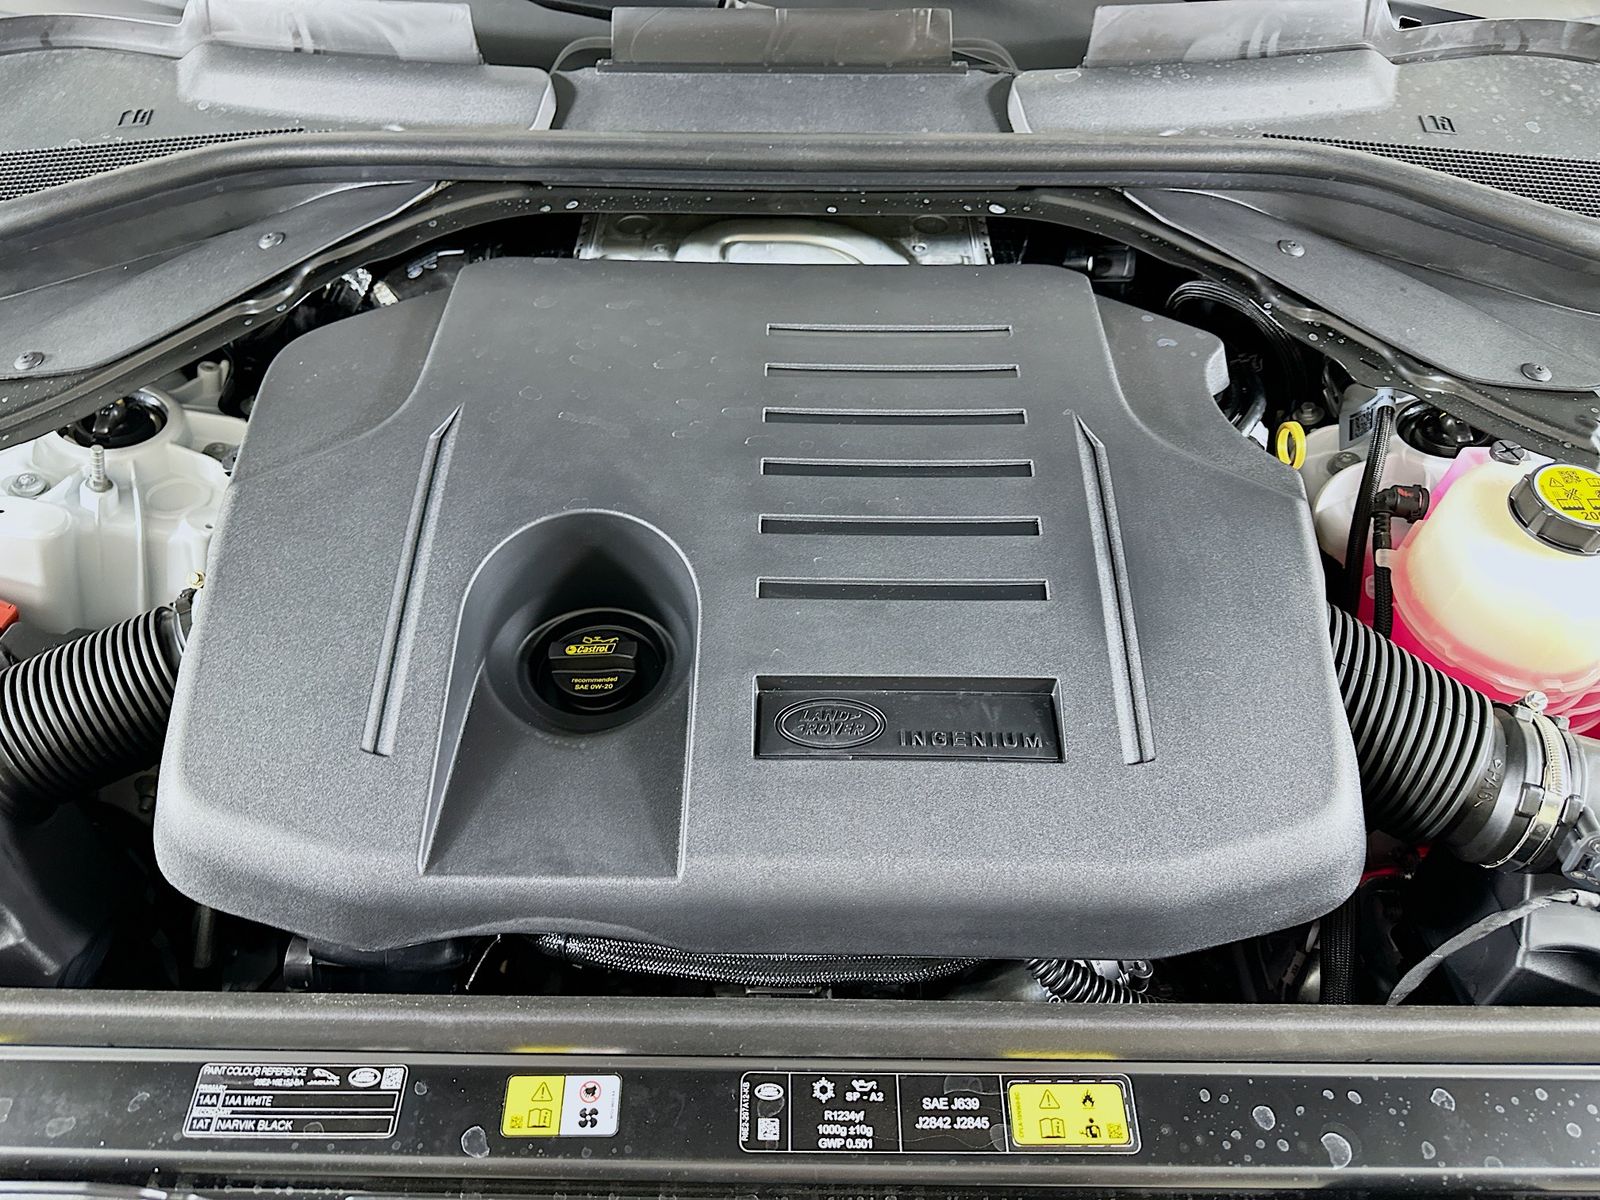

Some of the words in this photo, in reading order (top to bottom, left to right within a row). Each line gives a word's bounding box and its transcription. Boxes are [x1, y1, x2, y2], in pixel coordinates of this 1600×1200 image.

[1581, 511, 1600, 521] 20
[577, 645, 609, 653] Castrol
[800, 709, 851, 721] LAND
[804, 722, 866, 736] ROVER
[899, 730, 1043, 748] INGENIUM
[203, 1066, 227, 1075] PAINT
[226, 1066, 261, 1077] COLOUR
[261, 1067, 307, 1076] REFERENCE
[199, 1094, 217, 1105] 1AA
[224, 1095, 242, 1106] 1AA
[242, 1095, 273, 1106] WHITE
[845, 1091, 861, 1102] SP
[869, 1091, 884, 1102] A2
[922, 1097, 950, 1110] SAE
[950, 1097, 980, 1110] J639
[824, 1110, 866, 1124] R1234yf
[915, 1116, 952, 1129] J2842
[953, 1116, 990, 1129] J2845
[192, 1119, 211, 1130] 1AT
[216, 1119, 256, 1131] NARVIK
[257, 1120, 294, 1131] BLACK
[817, 1124, 848, 1137] 1000g
[818, 1137, 845, 1149] GWP
[845, 1137, 873, 1149] 0.501
